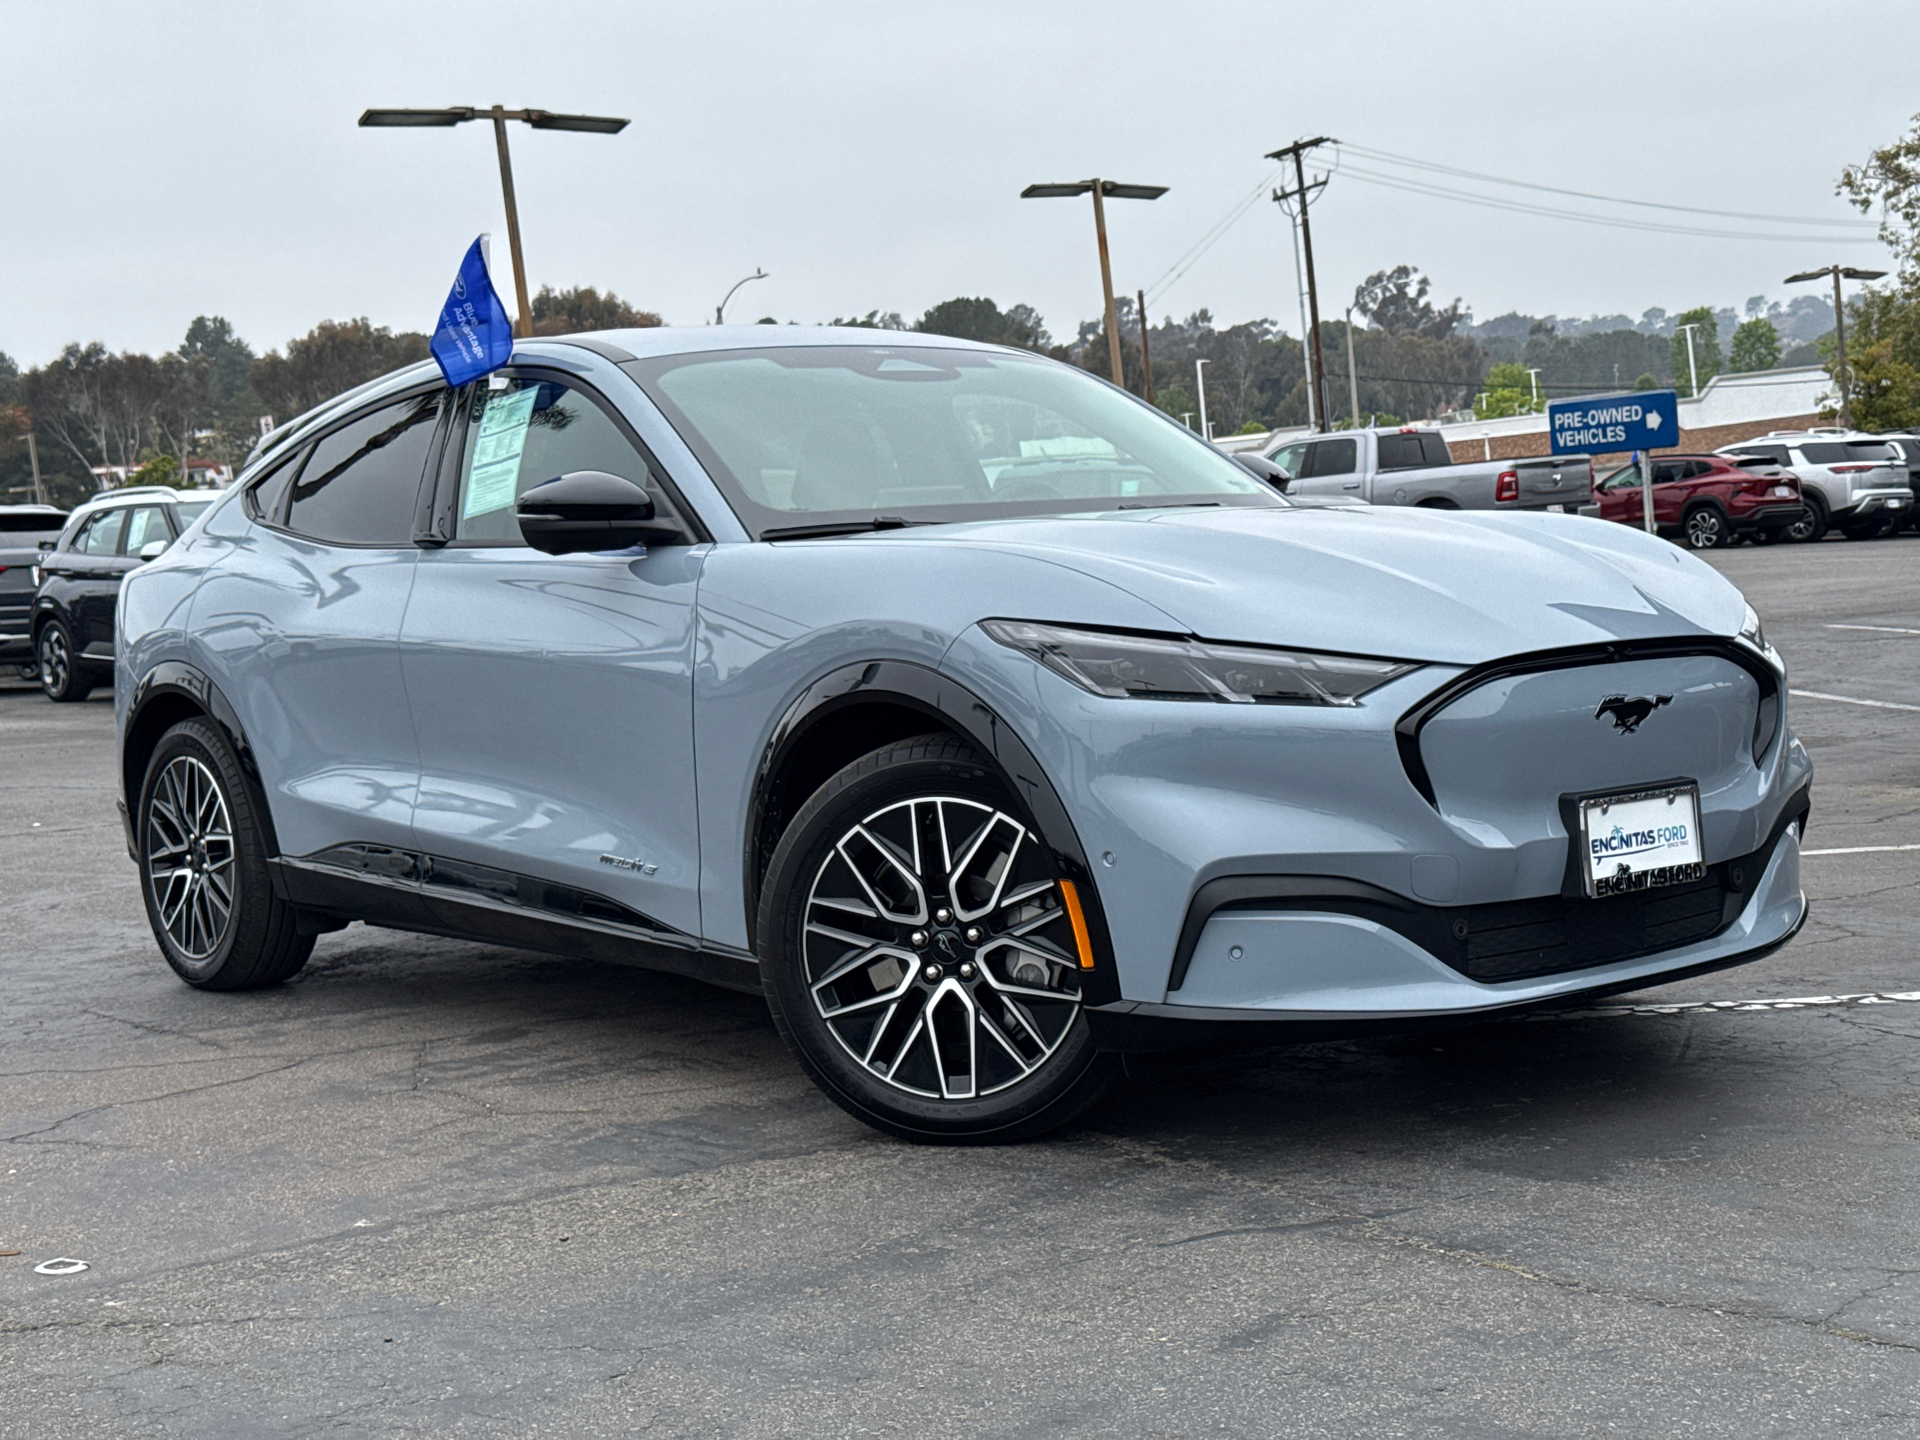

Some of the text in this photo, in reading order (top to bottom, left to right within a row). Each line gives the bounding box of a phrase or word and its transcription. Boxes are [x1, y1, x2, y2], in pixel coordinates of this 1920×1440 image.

[463, 302, 479, 326] Blue
[453, 307, 484, 359] Advantage
[1554, 405, 1643, 430] PRE-OWNED
[1556, 425, 1627, 447] VEHICLES
[1591, 824, 1688, 854] ENCINITAS FORD
[1595, 862, 1703, 896] ENCINITAS FORD
